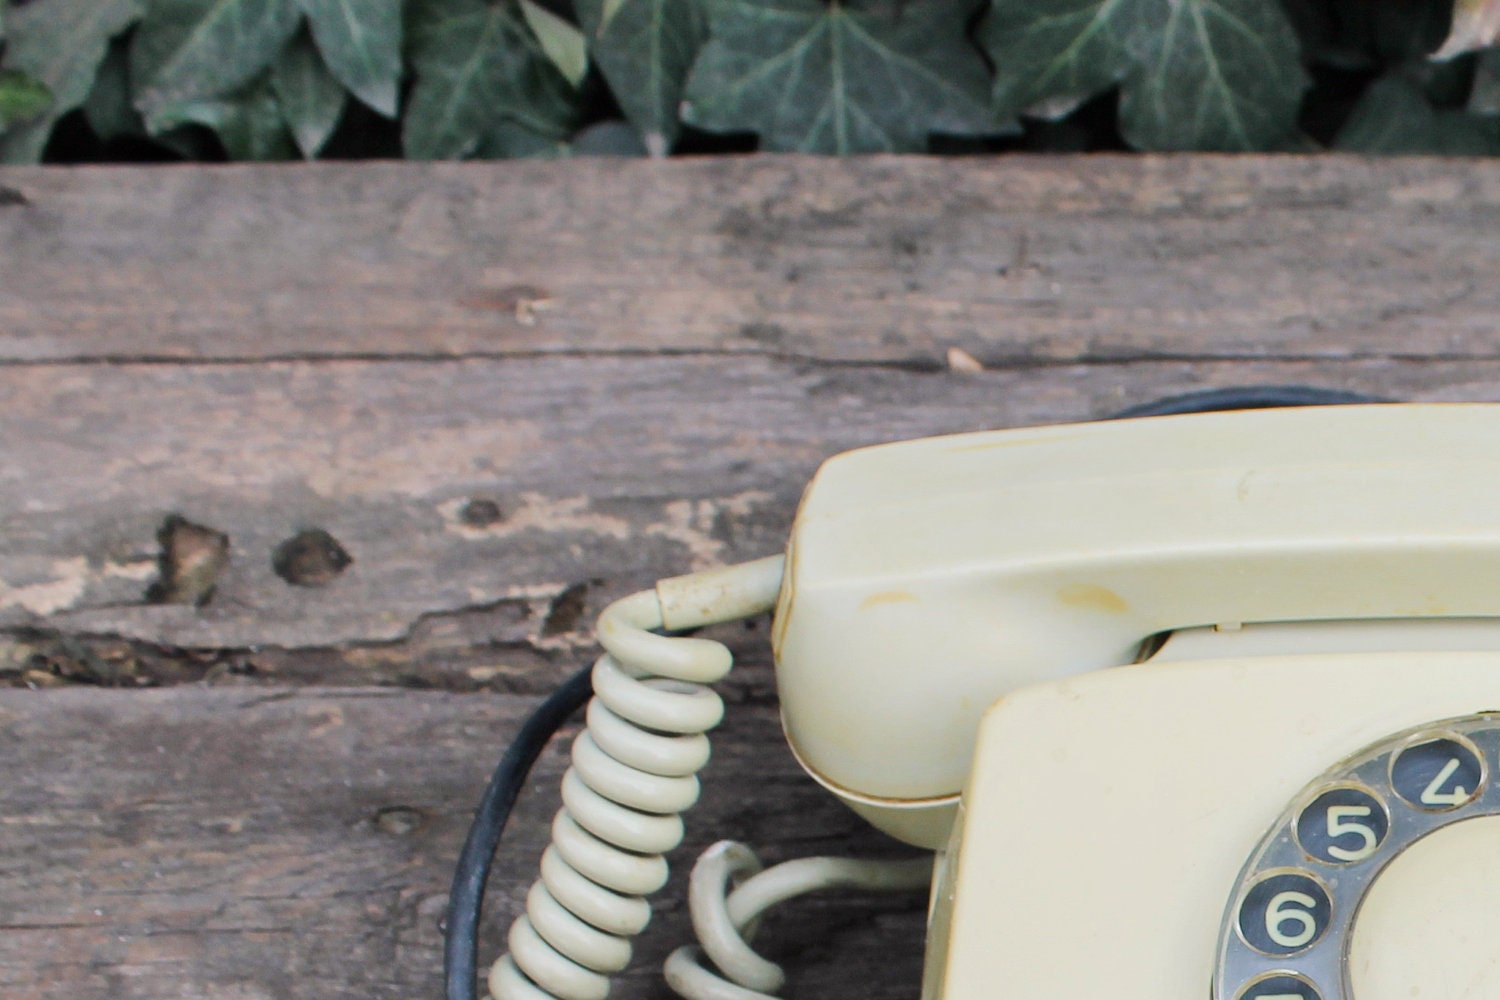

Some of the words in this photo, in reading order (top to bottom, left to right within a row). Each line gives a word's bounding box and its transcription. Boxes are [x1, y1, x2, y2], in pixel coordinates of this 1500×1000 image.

[1421, 757, 1471, 805] 4
[1326, 806, 1377, 862] 5
[1265, 891, 1316, 947] 6
